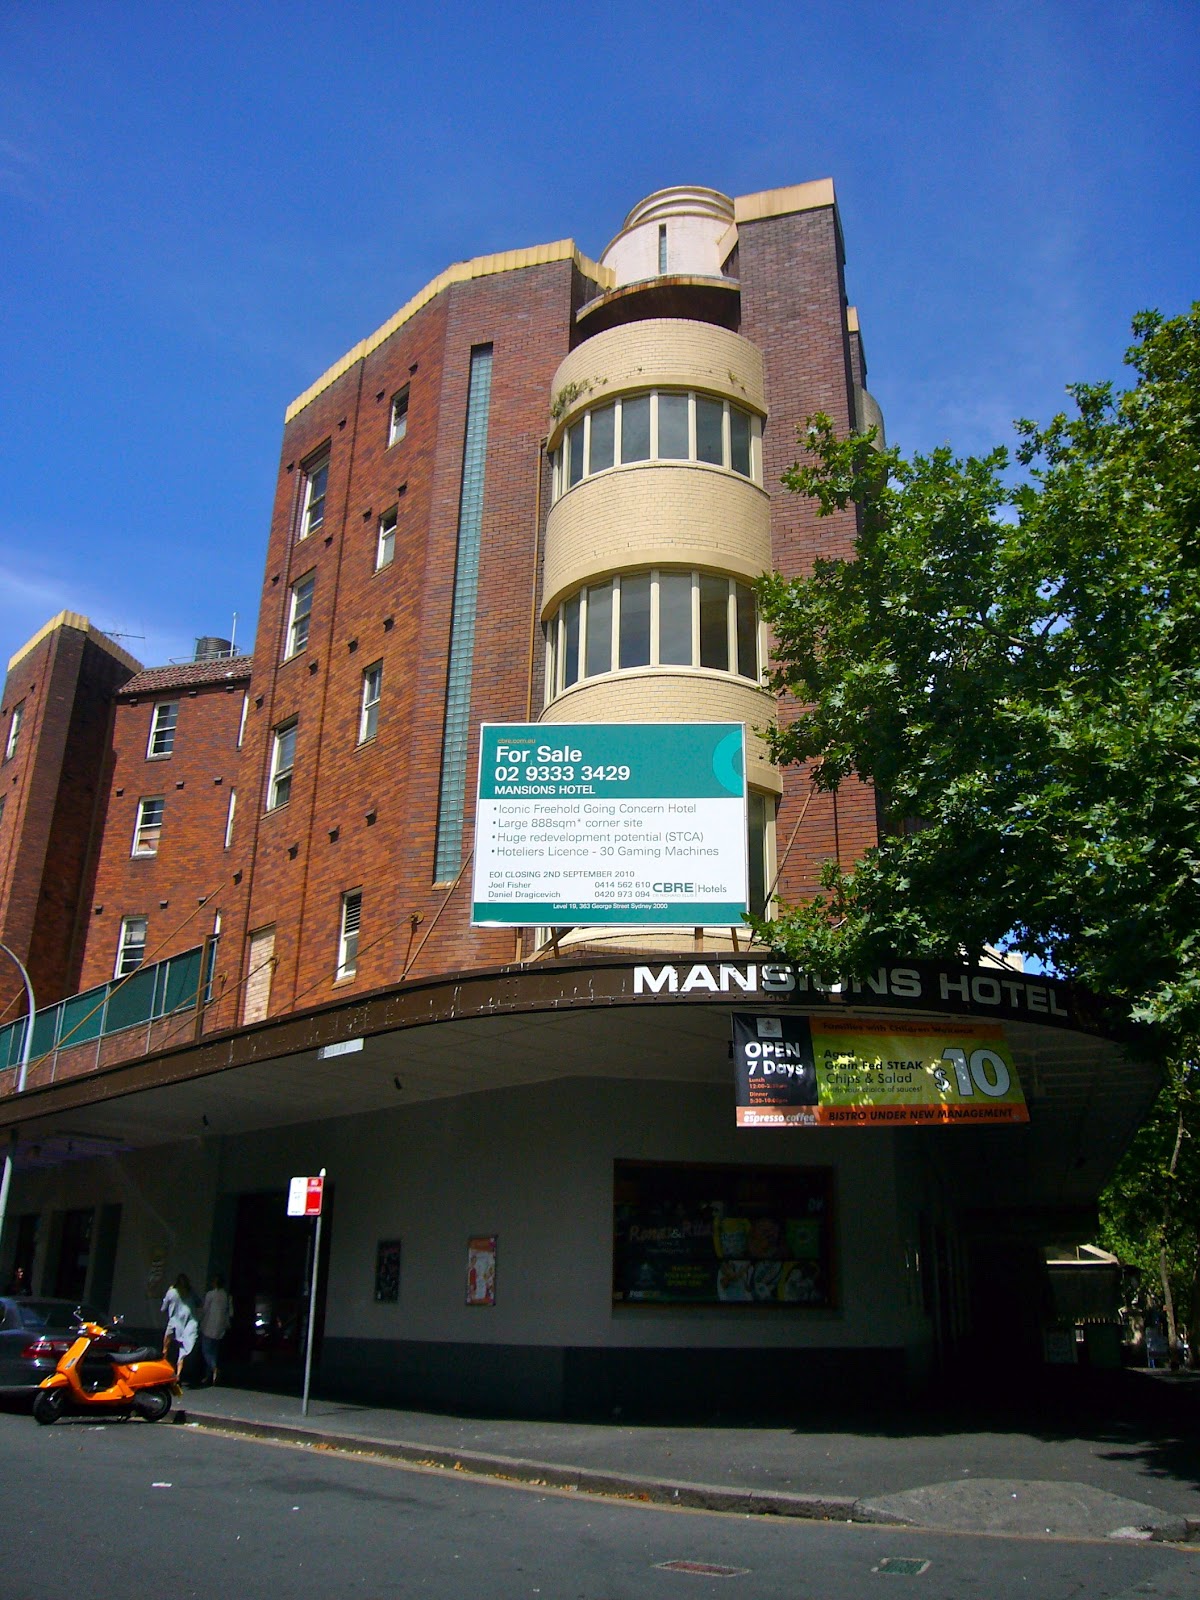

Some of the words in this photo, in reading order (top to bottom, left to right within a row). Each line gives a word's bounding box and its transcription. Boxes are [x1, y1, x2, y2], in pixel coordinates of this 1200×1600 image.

[496, 746, 531, 762] For
[537, 746, 582, 762] Sale
[494, 767, 518, 782] 02
[526, 766, 574, 781] 9333
[581, 766, 630, 781] 3429
[494, 785, 555, 795] MANSIONS
[559, 785, 595, 794] HOTEL
[498, 804, 530, 814] Iconic
[534, 804, 580, 814] Freehold
[583, 804, 616, 815] Going
[619, 804, 664, 813] Concern
[668, 804, 696, 813] Hotel
[498, 819, 528, 830] Large
[585, 820, 620, 828] corner
[623, 819, 643, 828] site
[497, 833, 526, 844] Huge
[530, 833, 610, 844] redevelopment
[614, 833, 662, 844] potential
[665, 833, 704, 843] (STCA)
[497, 847, 544, 856] Hoteliers
[548, 847, 589, 856] Licence
[600, 847, 614, 856] 30
[617, 847, 661, 858] Gaming
[665, 847, 719, 856] Machines
[652, 882, 694, 893] CBRE
[697, 884, 727, 893] Hotels
[515, 891, 561, 899] Dragicevich
[633, 963, 922, 998] MANSIONS
[939, 973, 1068, 1017] HOTEL
[744, 1041, 801, 1058] OPEN
[823, 1050, 854, 1060] Aged
[747, 1061, 758, 1075] 7
[763, 1061, 804, 1077] Days
[824, 1061, 858, 1070] Grain
[862, 1061, 883, 1070] Fed
[887, 1061, 923, 1070] STEAK
[826, 1074, 861, 1085] Chips
[865, 1074, 874, 1083] &
[878, 1073, 912, 1083] Salad
[744, 1114, 784, 1125] espresso
[786, 1113, 814, 1121] coffee
[828, 1111, 866, 1120] BISTRO
[871, 1111, 906, 1119] UNDER
[910, 1111, 935, 1119] NEW
[937, 1109, 1012, 1118] MANAGEMENT
